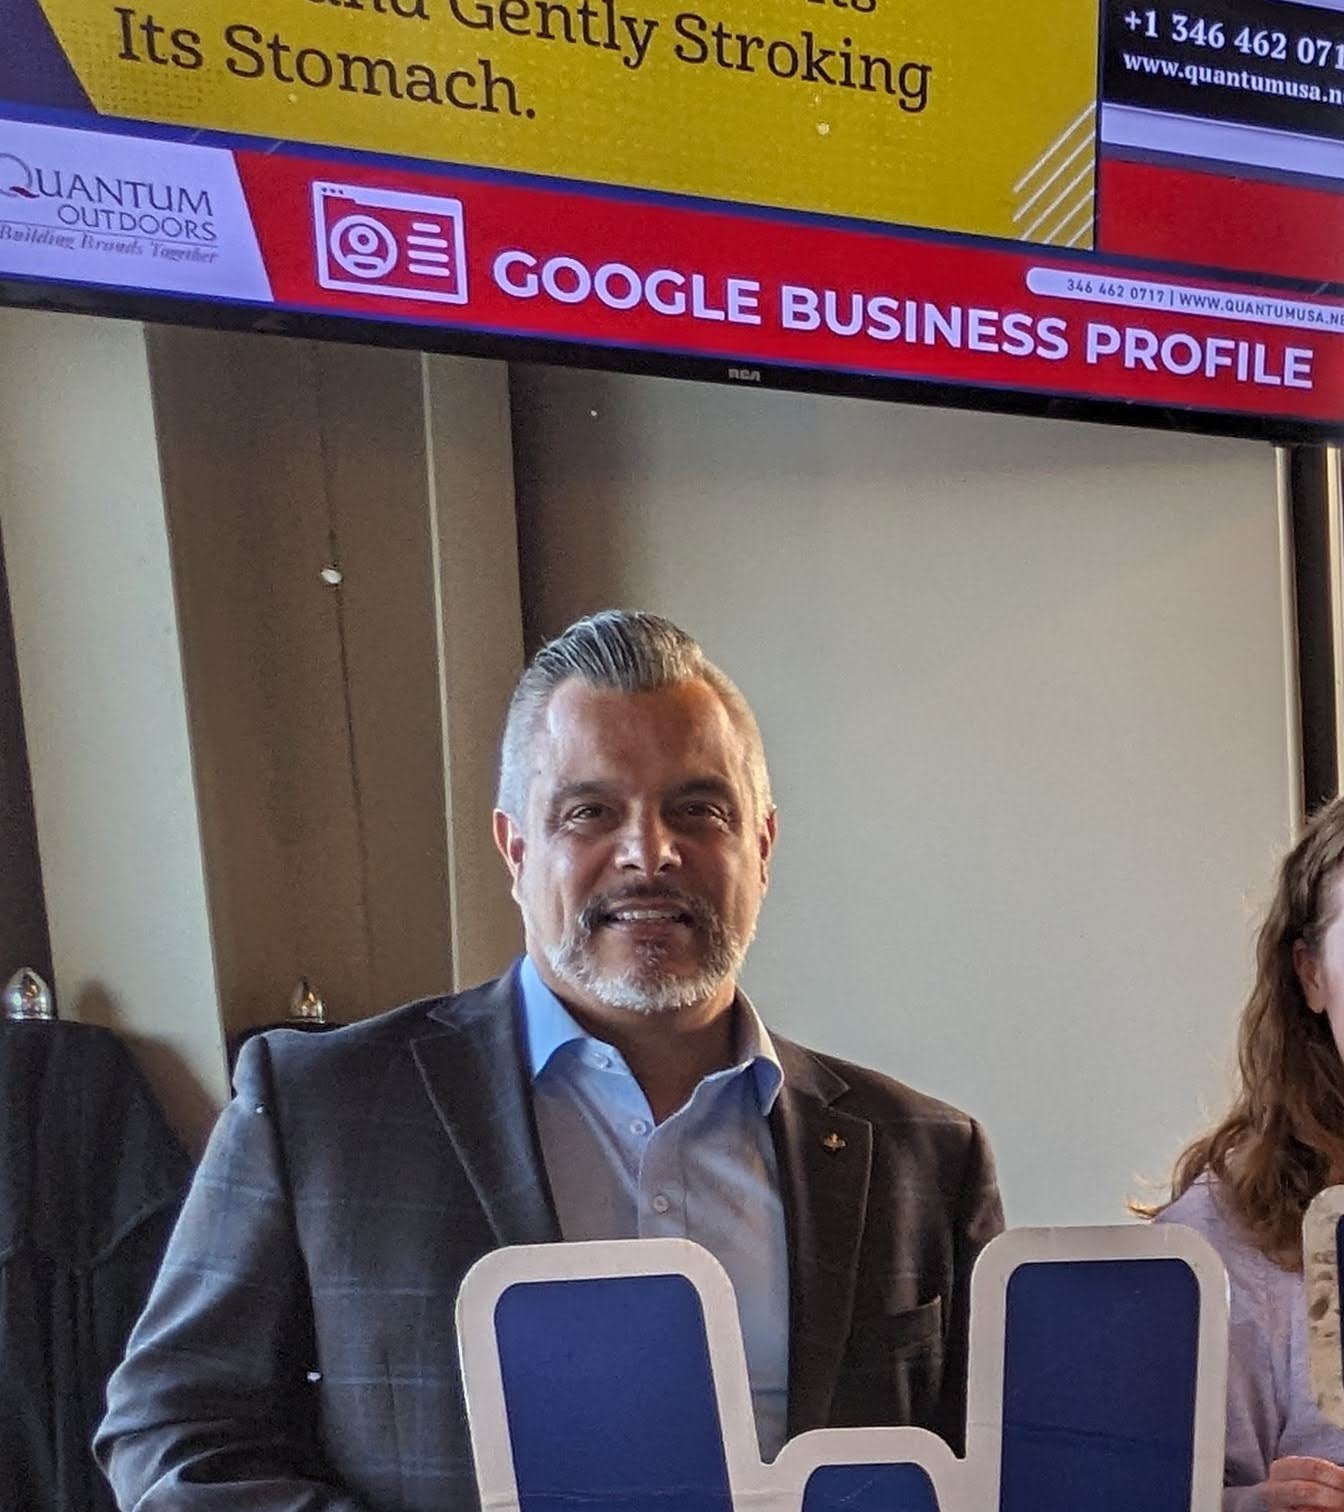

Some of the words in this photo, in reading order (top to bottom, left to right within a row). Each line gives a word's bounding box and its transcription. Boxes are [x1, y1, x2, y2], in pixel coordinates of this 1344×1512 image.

[114, 6, 203, 70] Its
[225, 24, 536, 119] Stomach.
[452, 0, 659, 69] Gently
[674, 14, 932, 112] Stroking
[1124, 10, 1158, 38] +1
[1171, 14, 1225, 49] 346
[1233, 27, 1287, 60] 462
[0, 153, 213, 217] QUANTUM
[57, 204, 217, 242] OUTDOORS
[493, 249, 762, 326] GOOGLE
[781, 284, 1069, 361] BUSINESS
[1087, 321, 1314, 389] PROFILE
[1067, 278, 1093, 295] 346
[1098, 282, 1125, 299] 462
[1130, 287, 1165, 304] 0717
